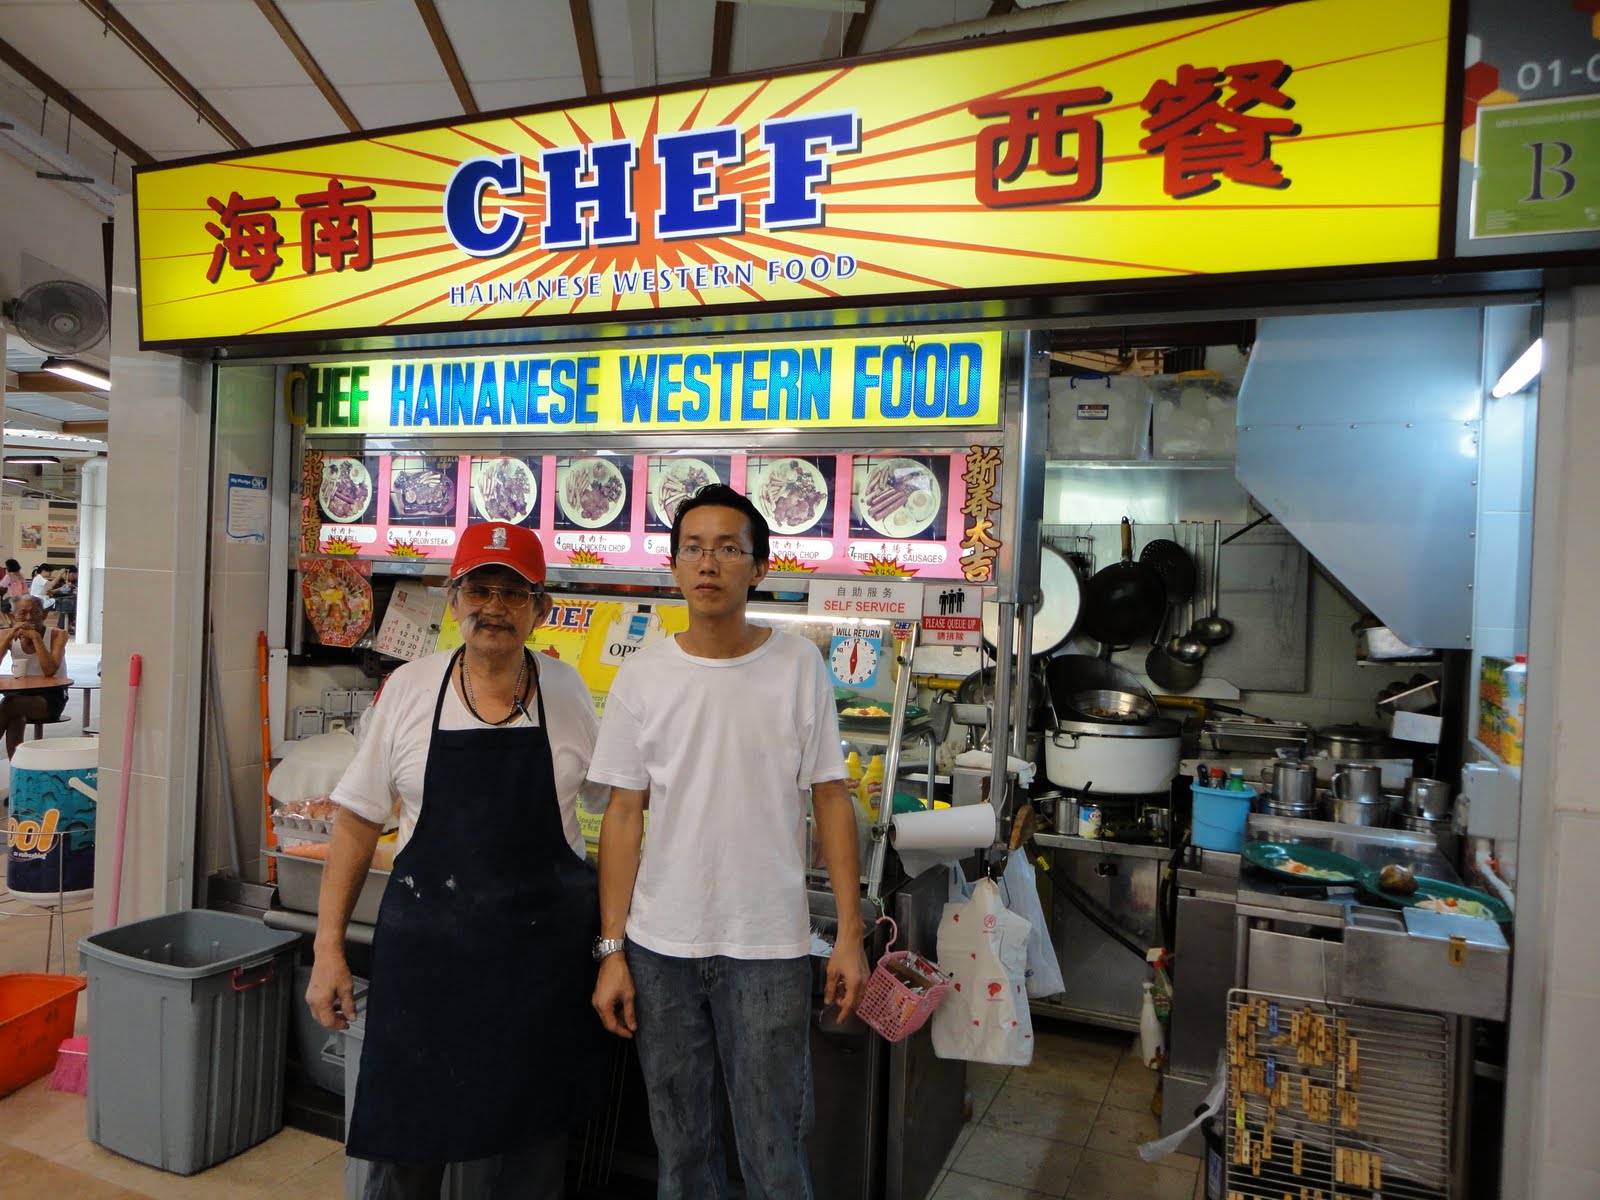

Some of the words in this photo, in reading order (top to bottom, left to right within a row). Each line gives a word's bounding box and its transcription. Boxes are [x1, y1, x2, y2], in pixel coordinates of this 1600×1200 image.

[970, 59, 1302, 208] 西餐
[1519, 140, 1576, 203] B
[443, 108, 861, 259] CHEF
[206, 177, 377, 284] 海南
[449, 273, 602, 307] HAINANESE
[613, 262, 754, 295] WESTERN
[768, 255, 858, 285] FOOD
[390, 357, 600, 427] HAINANESE
[618, 347, 833, 423] WESTERN
[853, 341, 982, 419] FOOD
[959, 445, 1002, 583] 新春大吉
[556, 536, 561, 546] 4
[647, 540, 653, 549] 5
[581, 544, 607, 552] CHICKEN
[850, 547, 855, 556] 7
[800, 551, 819, 559] CHOP
[877, 553, 892, 561] EGG
[902, 555, 943, 563] SAUSAGES
[837, 586, 892, 598] 自助服务
[823, 600, 851, 611] SELF
[855, 601, 906, 613] SERVICE
[925, 618, 946, 629] PLEASE
[947, 619, 966, 630] QUEUE
[969, 620, 977, 631] UP
[836, 628, 852, 636] WILL
[853, 629, 880, 638] RETURN
[393, 647, 402, 655] 26
